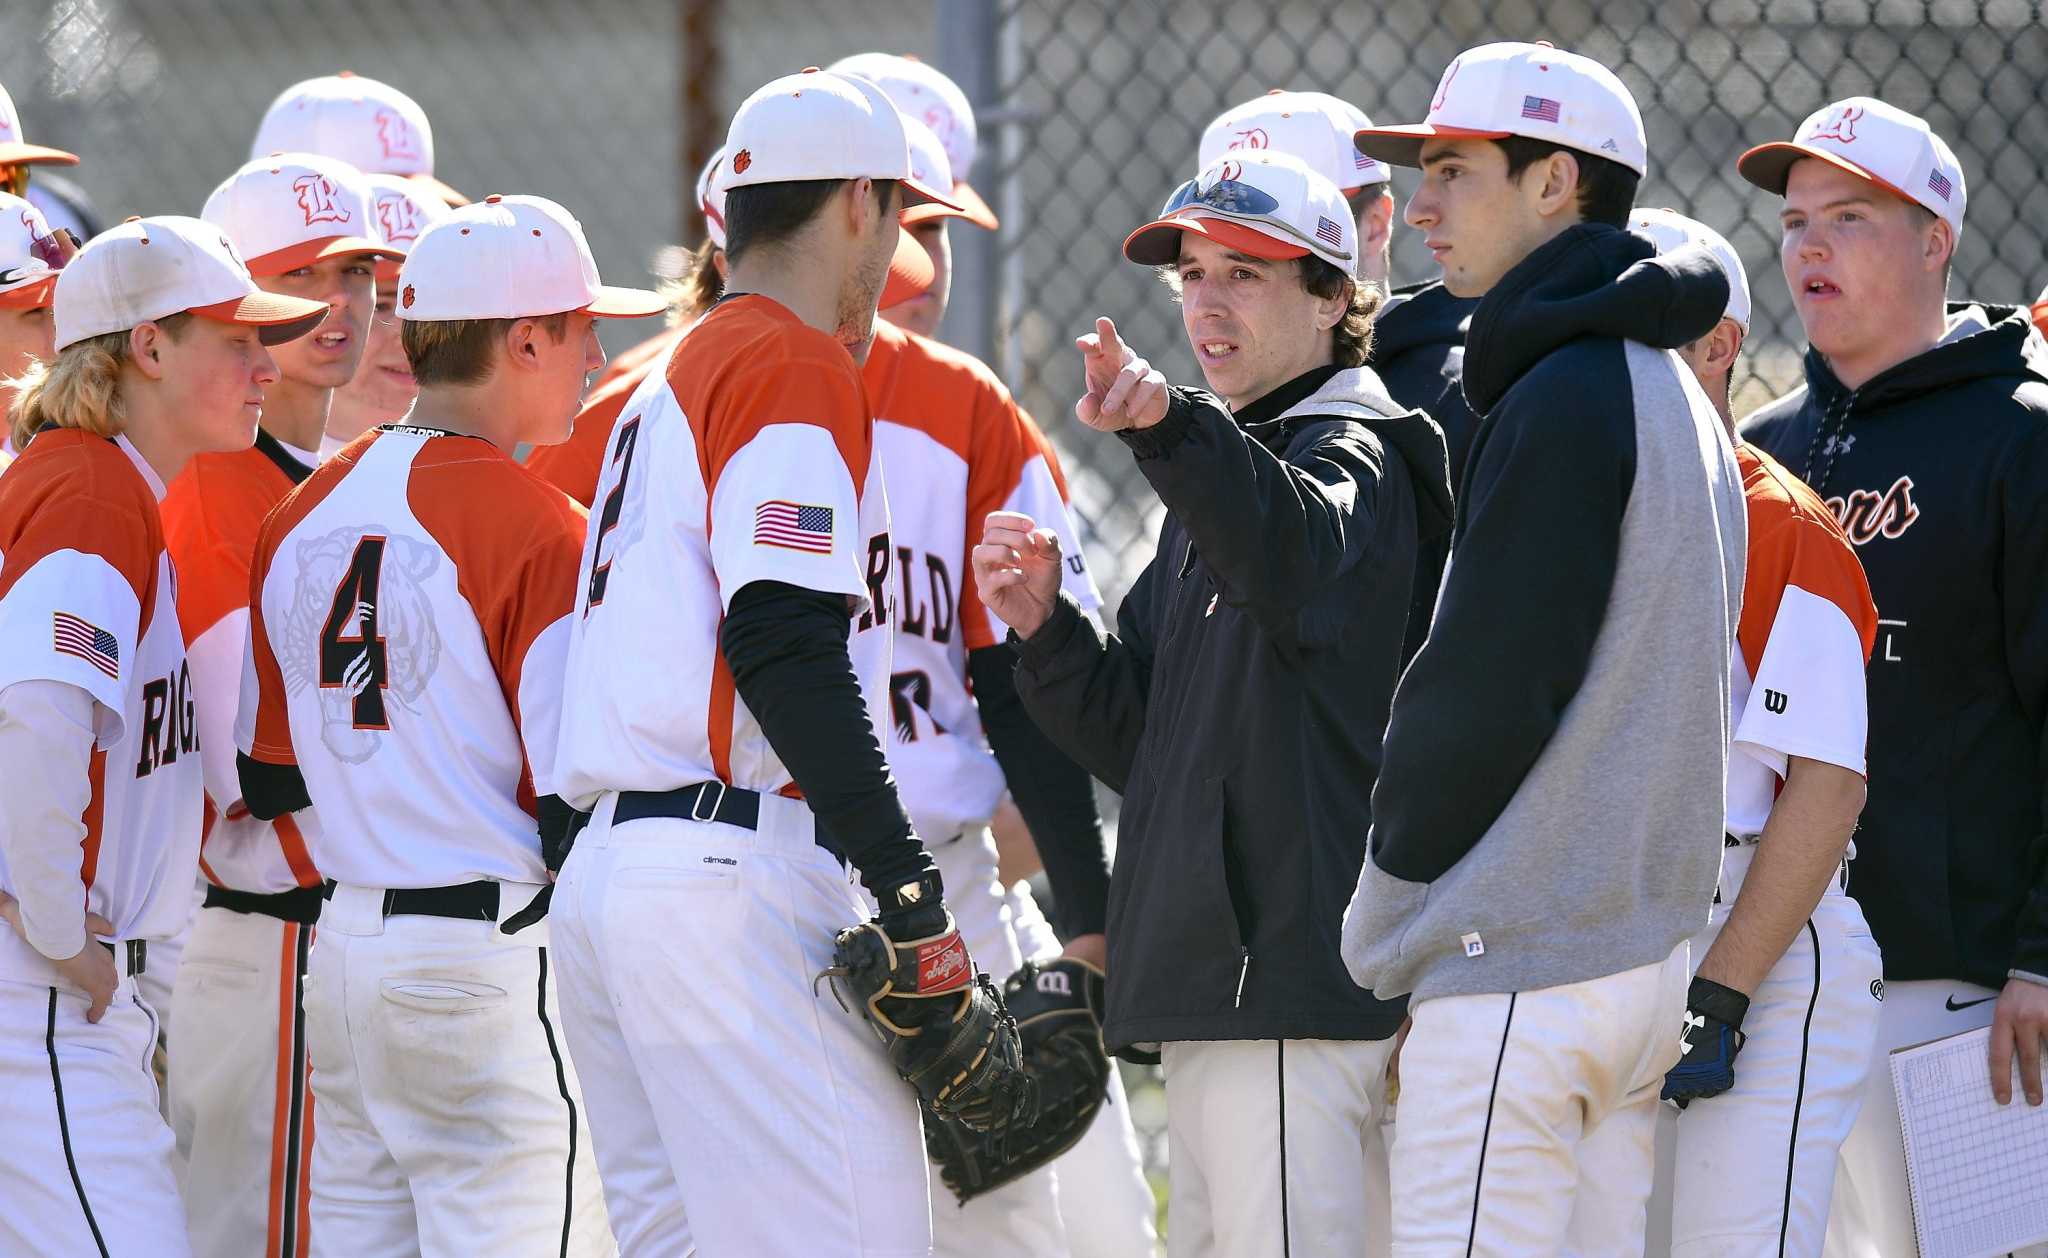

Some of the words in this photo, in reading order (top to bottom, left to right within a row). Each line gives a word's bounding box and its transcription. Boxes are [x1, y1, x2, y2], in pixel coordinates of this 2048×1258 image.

[293, 174, 351, 226] R
[319, 535, 390, 730] 4
[893, 545, 954, 645] LD
